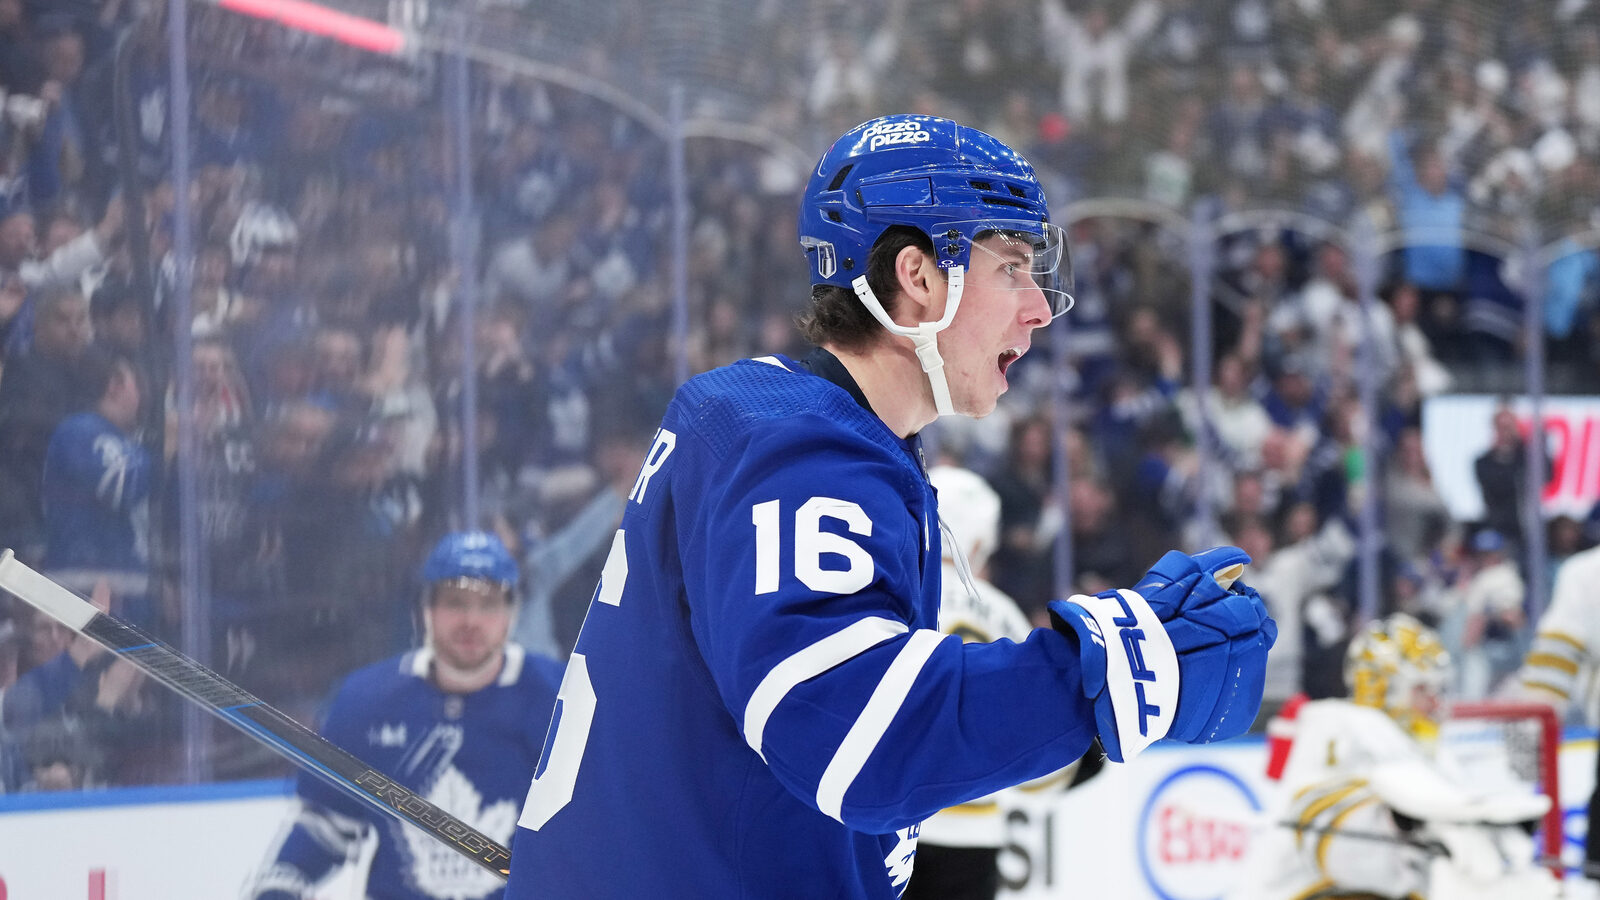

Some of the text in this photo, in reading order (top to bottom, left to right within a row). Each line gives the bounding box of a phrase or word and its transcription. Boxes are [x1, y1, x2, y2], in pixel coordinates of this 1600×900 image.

[860, 121, 921, 144] pizza
[870, 130, 930, 152] pizza
[628, 427, 677, 505] R
[752, 496, 875, 596] 16
[1079, 613, 1106, 649] 16
